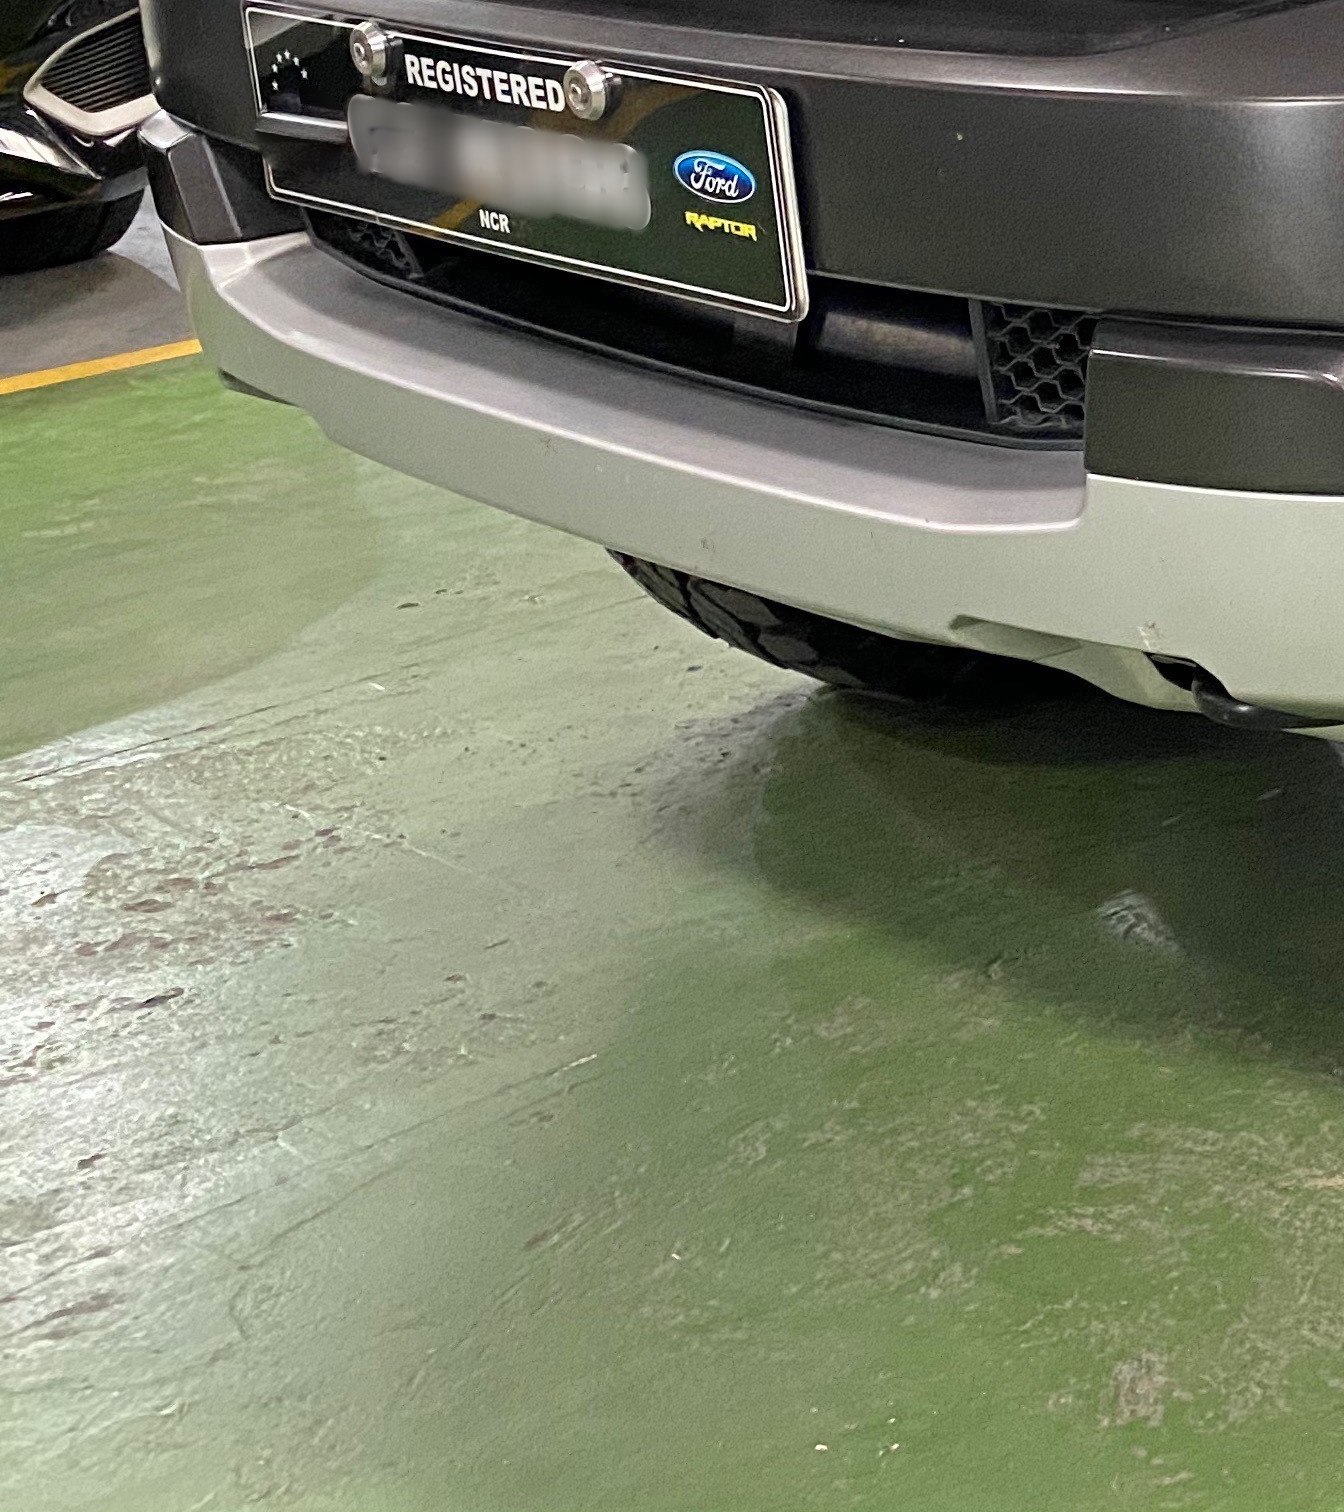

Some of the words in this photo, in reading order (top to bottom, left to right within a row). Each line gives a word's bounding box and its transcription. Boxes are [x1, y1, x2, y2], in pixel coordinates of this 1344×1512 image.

[404, 53, 566, 113] REGISTERED
[690, 157, 739, 198] Ford
[478, 208, 511, 234] NCR
[684, 210, 758, 242] RAPTOR
